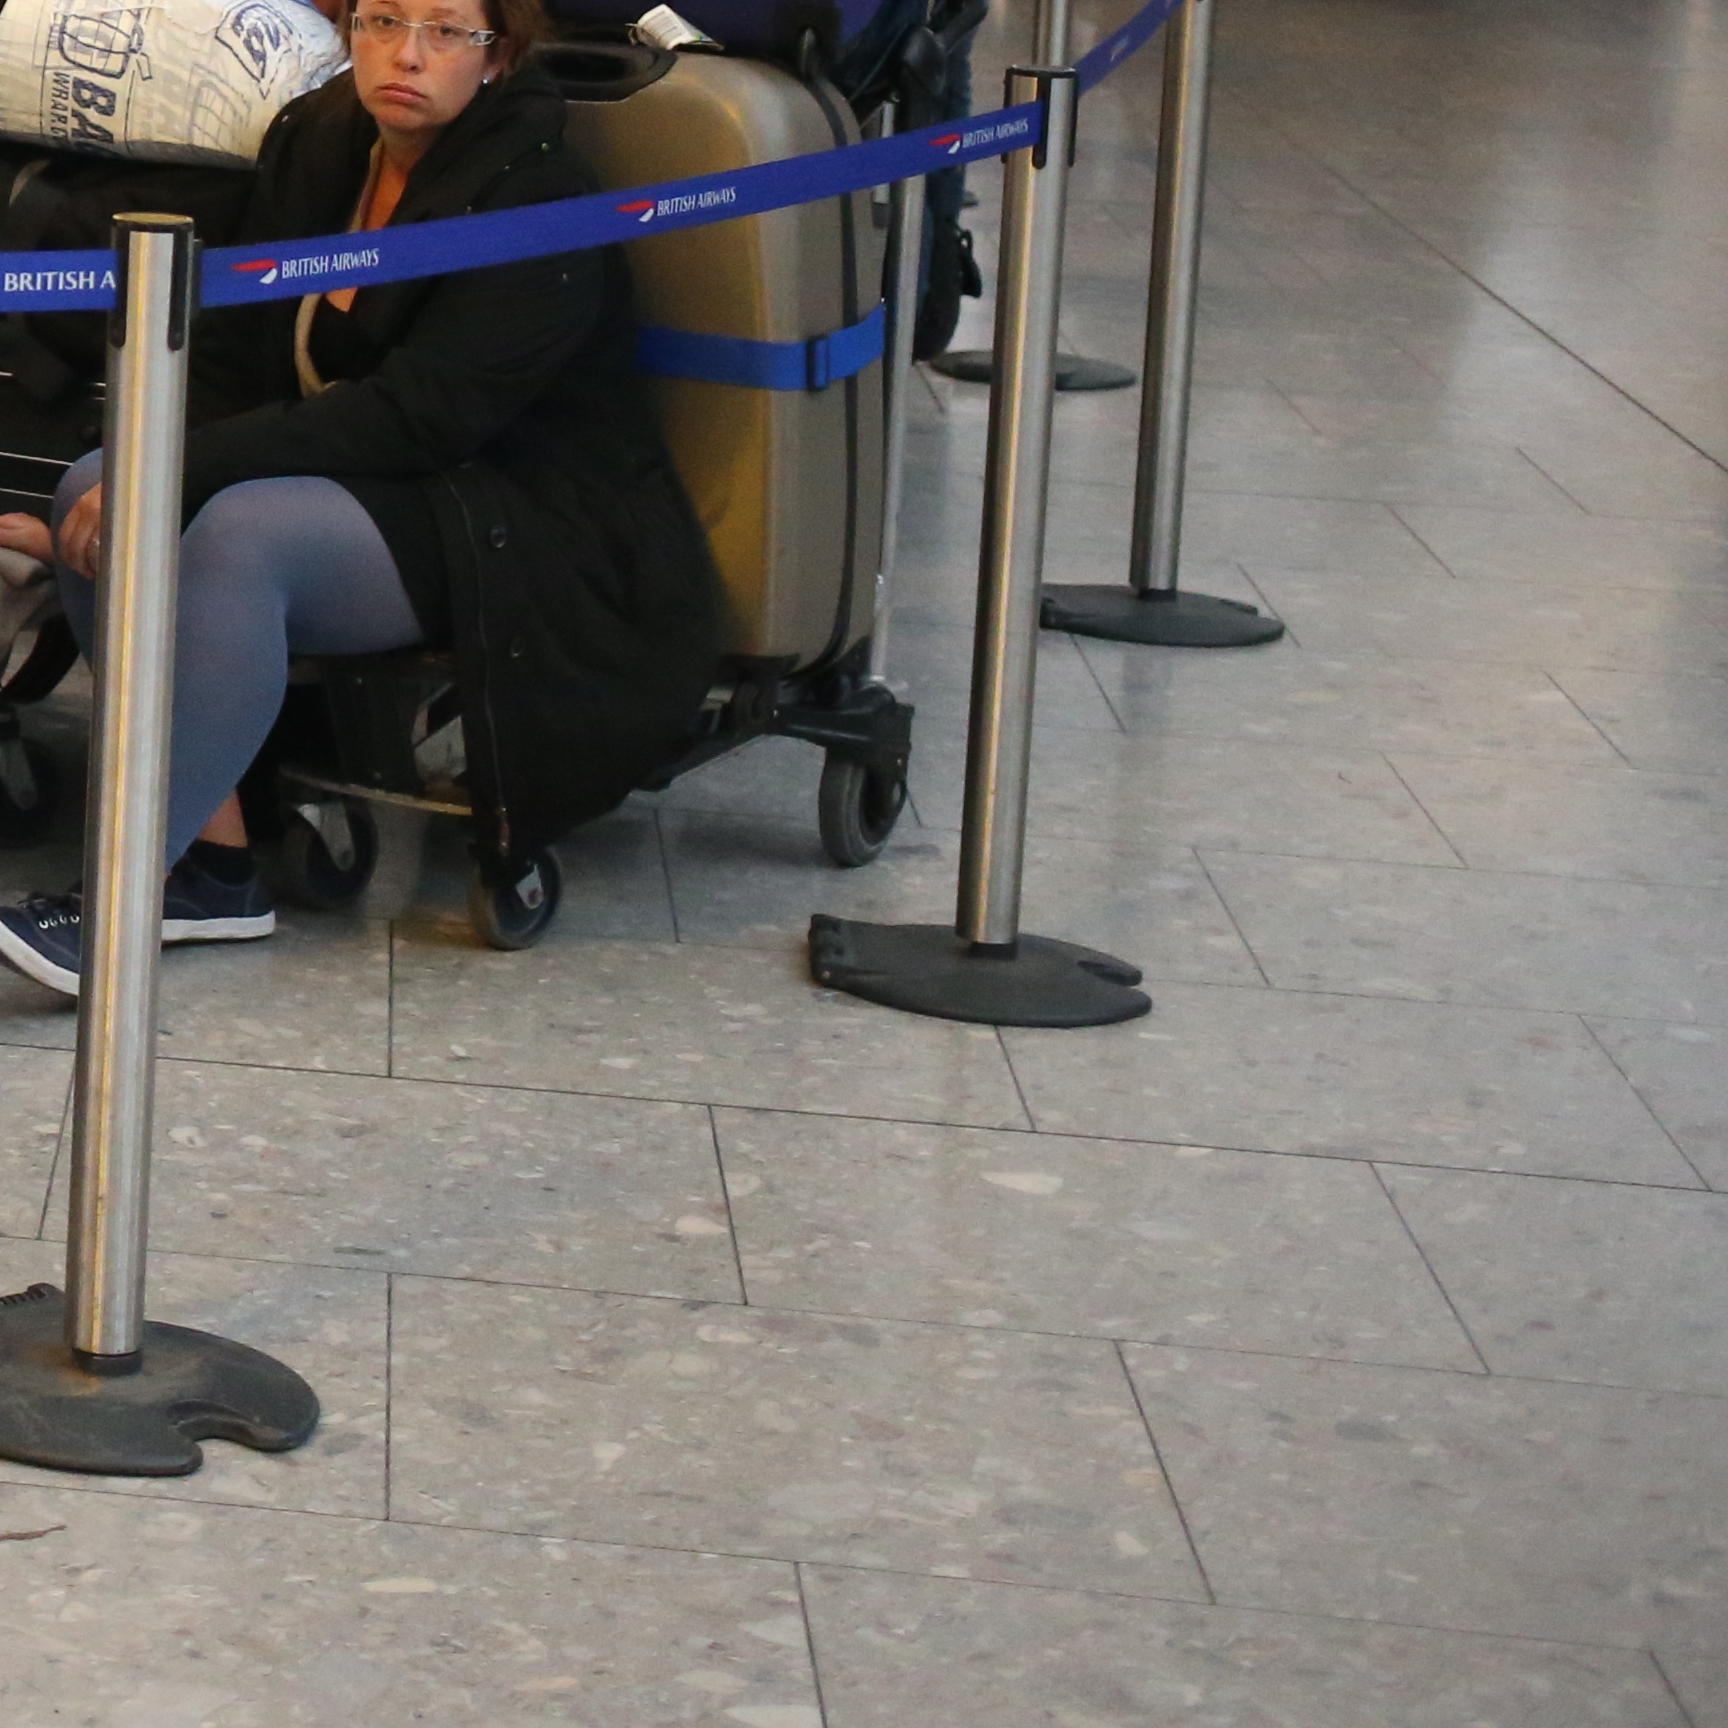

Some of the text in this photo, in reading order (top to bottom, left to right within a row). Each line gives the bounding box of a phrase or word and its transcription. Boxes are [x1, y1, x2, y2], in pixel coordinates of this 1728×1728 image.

[962, 117, 1029, 149] BRITISH AIRWAYS
[657, 185, 737, 217] BRITISH AIRWAYS
[281, 247, 380, 279] BRITISH AIRWAYS
[4, 270, 93, 292] BRITISH
